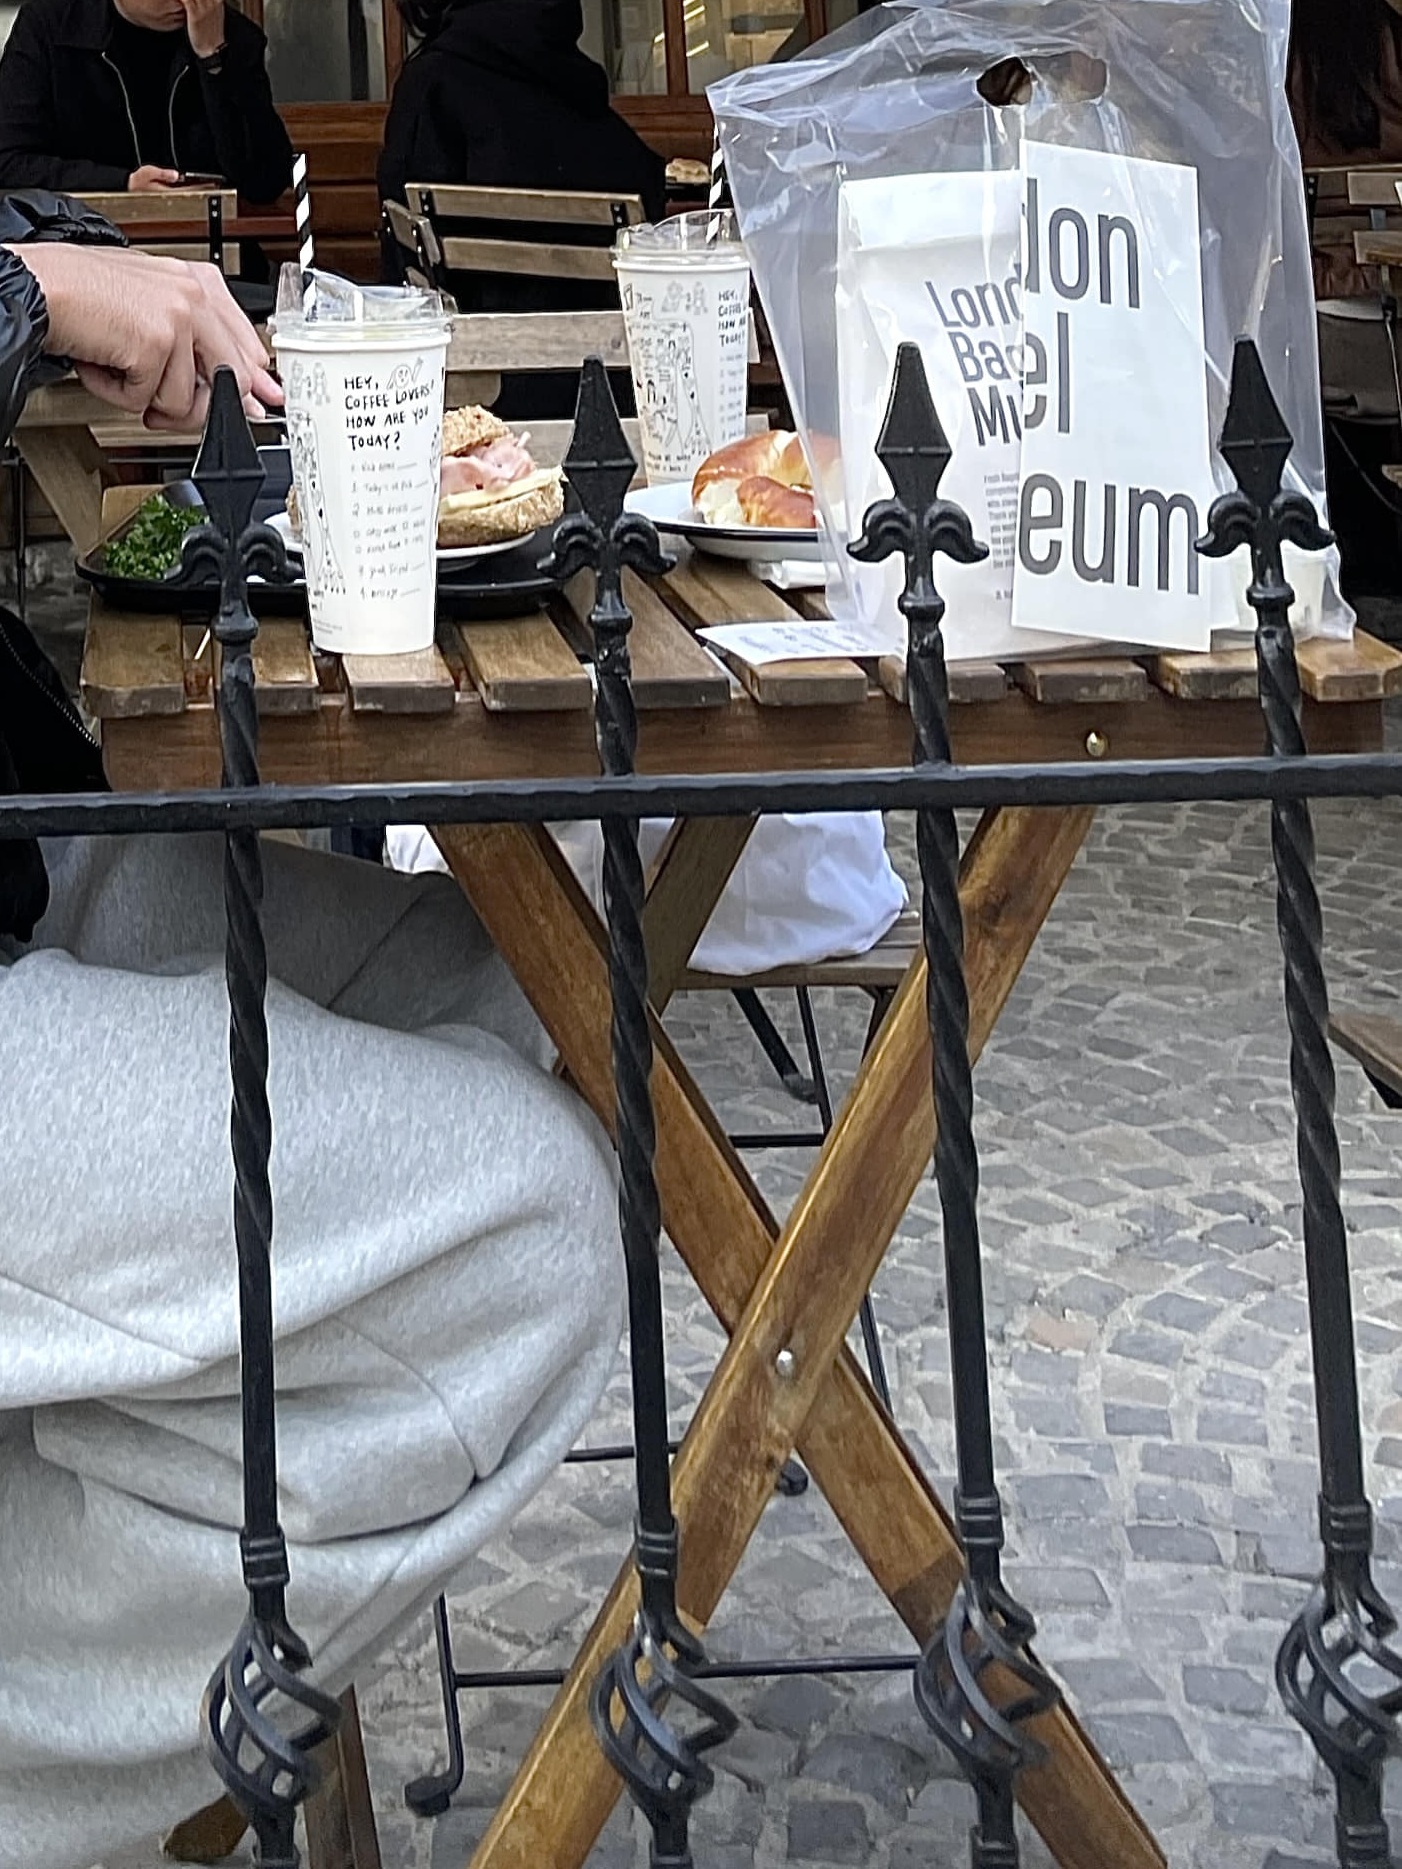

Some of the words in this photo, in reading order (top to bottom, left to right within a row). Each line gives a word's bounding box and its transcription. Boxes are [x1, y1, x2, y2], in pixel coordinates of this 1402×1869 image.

[344, 375, 379, 390] HEY,
[345, 394, 390, 411] COFFEE
[346, 414, 376, 429] HOW
[384, 410, 406, 427] ARE
[1018, 473, 1199, 595] eum
